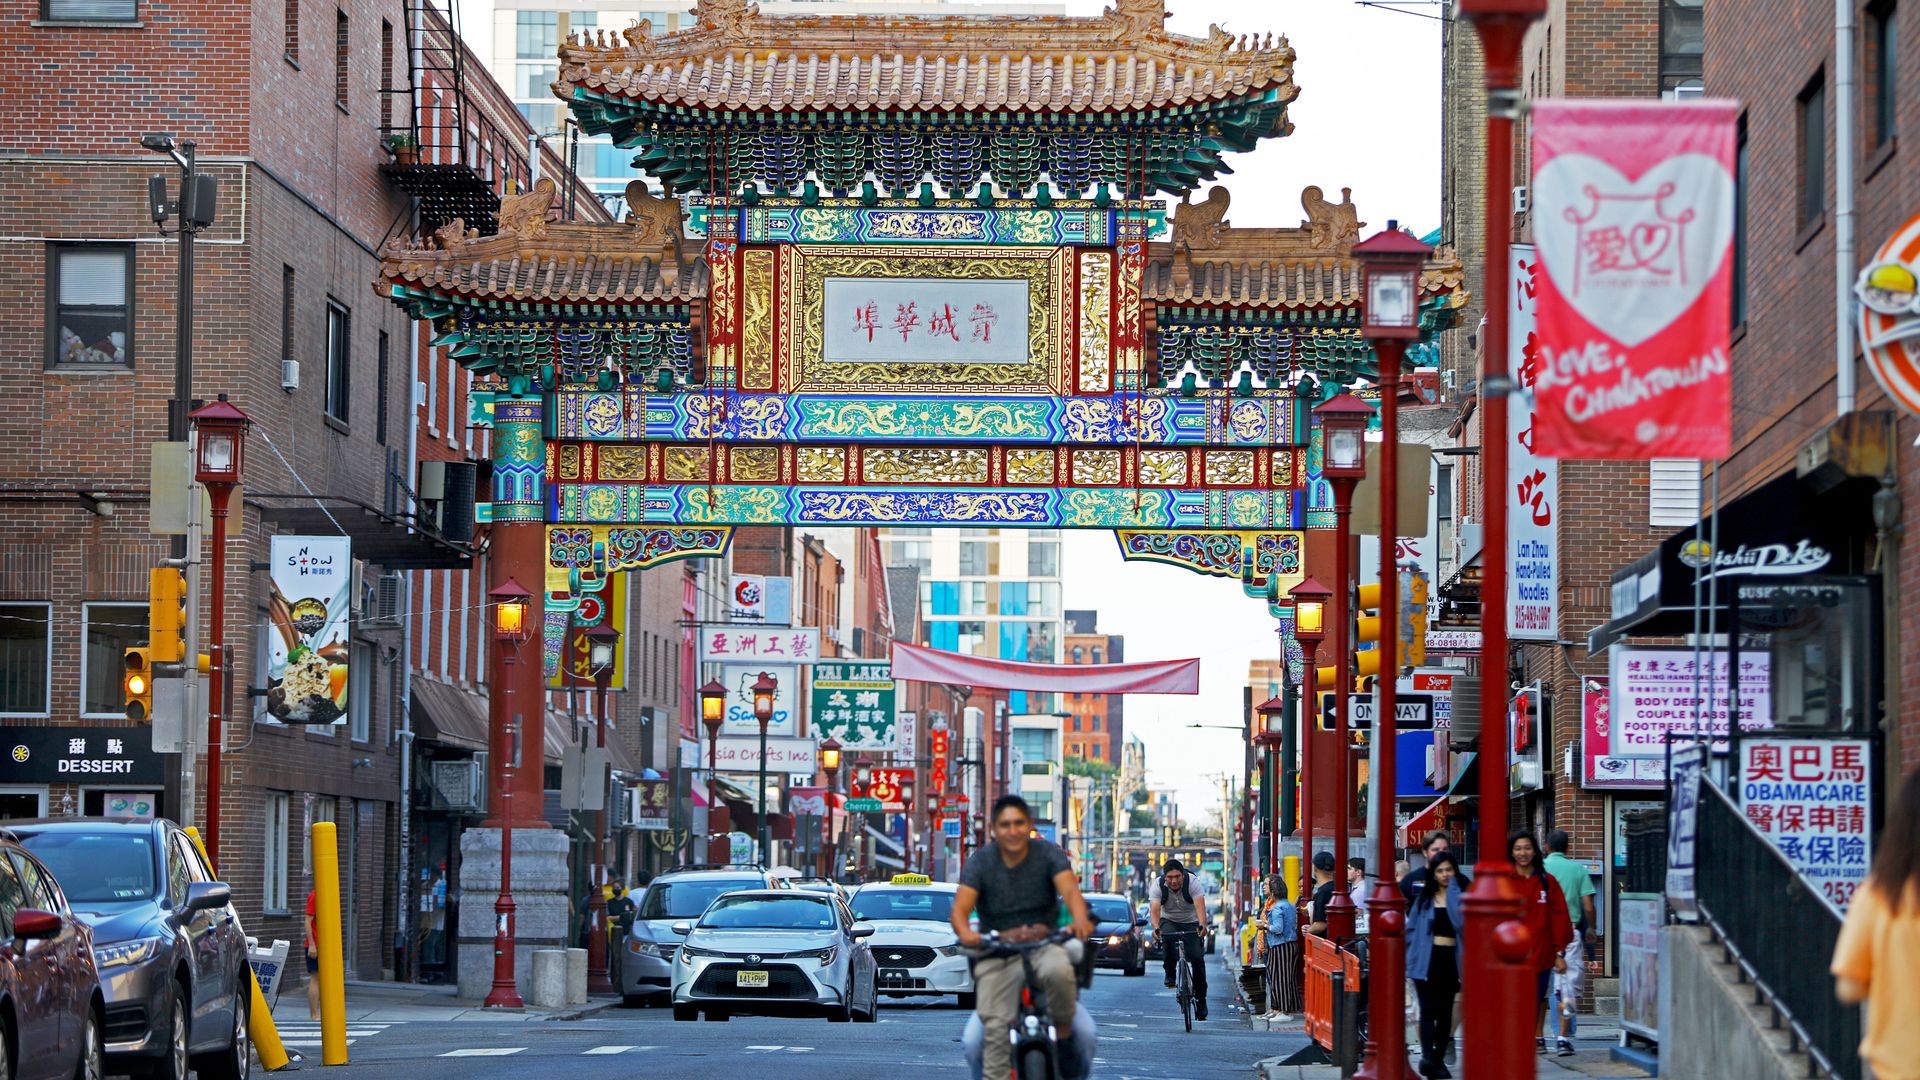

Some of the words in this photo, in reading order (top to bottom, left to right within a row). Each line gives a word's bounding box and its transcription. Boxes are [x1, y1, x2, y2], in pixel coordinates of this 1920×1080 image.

[1517, 540, 1530, 558] Lan
[1531, 540, 1549, 558] Zhou
[1515, 561, 1551, 579] Hand-Pulled
[1518, 583, 1549, 601] Noodles
[817, 665, 842, 680] TAI
[849, 666, 891, 680] LAKE
[1635, 698, 1669, 707] BODY
[1673, 698, 1705, 707] DEEP
[1637, 711, 1686, 719] COUPLE
[69, 738, 123, 754] 甜點
[788, 750, 813, 761] Inc.
[58, 760, 134, 773] DESSERT
[1746, 744, 1865, 783] 奧巴馬
[1745, 784, 1866, 802] OBAMACARE
[844, 802, 871, 811] Cherry
